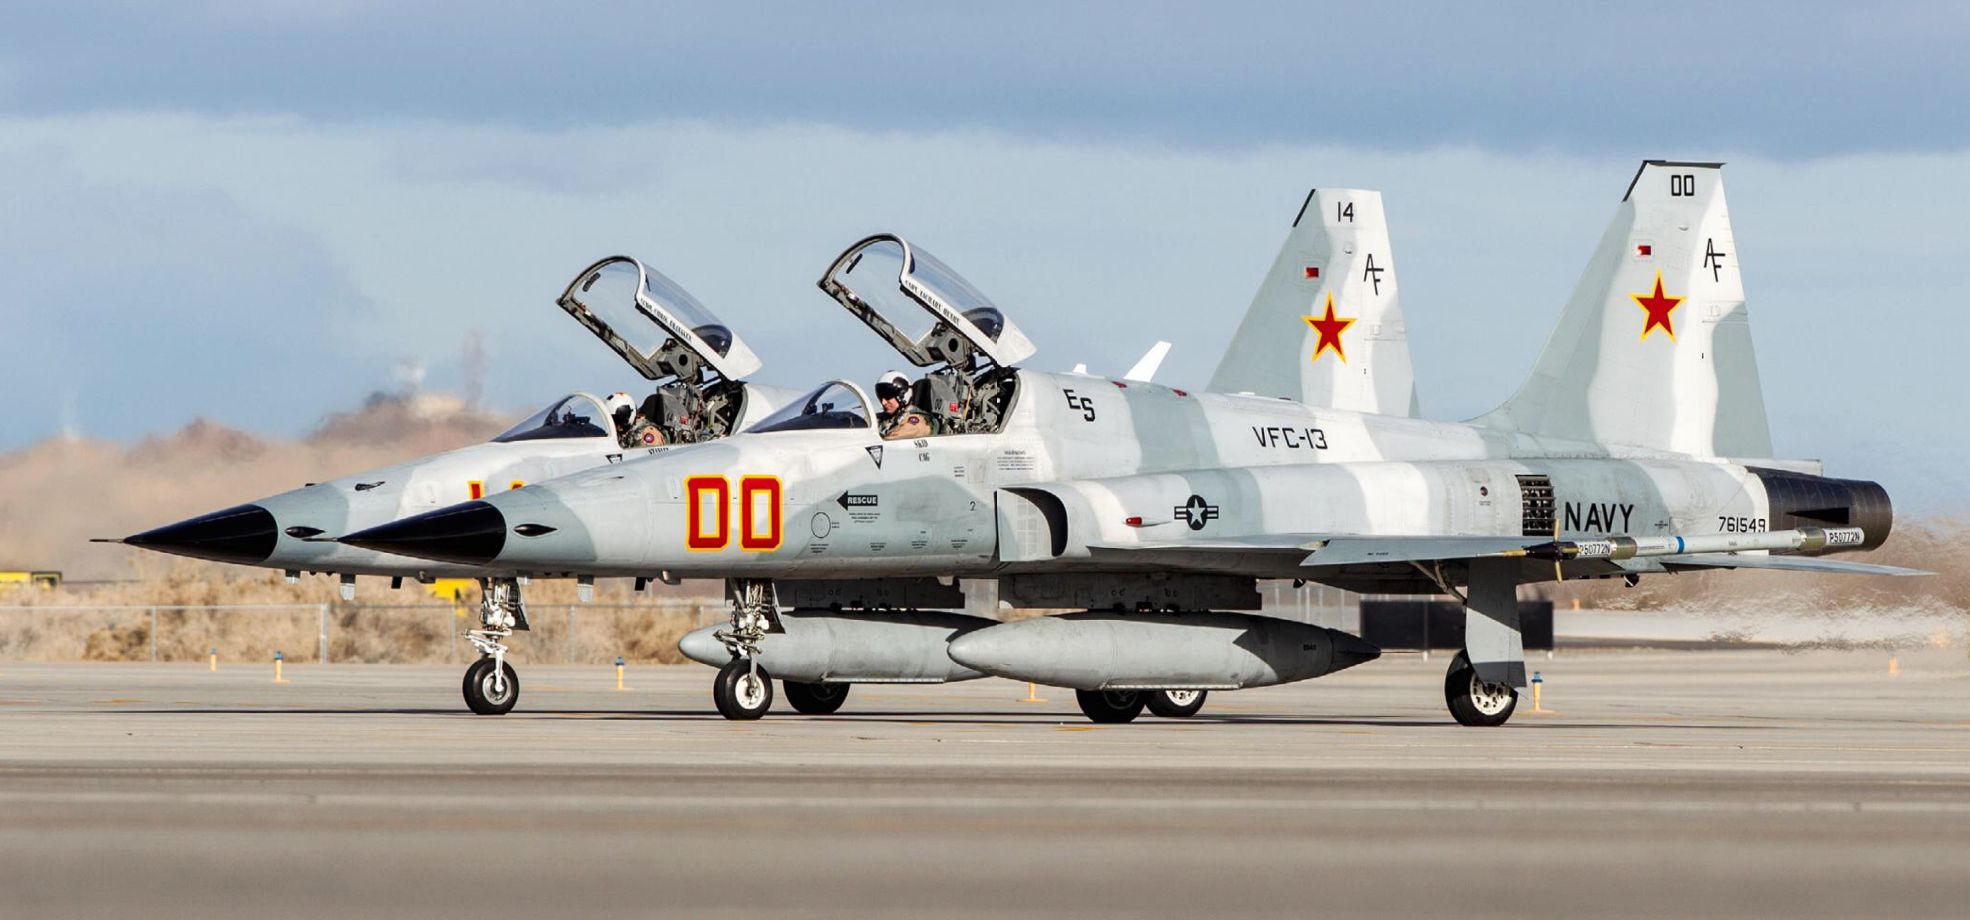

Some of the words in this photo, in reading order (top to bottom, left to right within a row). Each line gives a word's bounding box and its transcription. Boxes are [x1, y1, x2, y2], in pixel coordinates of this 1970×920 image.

[1671, 174, 1695, 197] 00
[1337, 201, 1354, 223] 14
[1252, 426, 1328, 450] VFC-13
[847, 496, 878, 505] RESCUE
[969, 500, 976, 512] 2
[683, 474, 785, 552] 00
[1564, 502, 1635, 534] NAVY
[1718, 516, 1766, 533] 761549
[1829, 532, 1861, 545] P50772N
